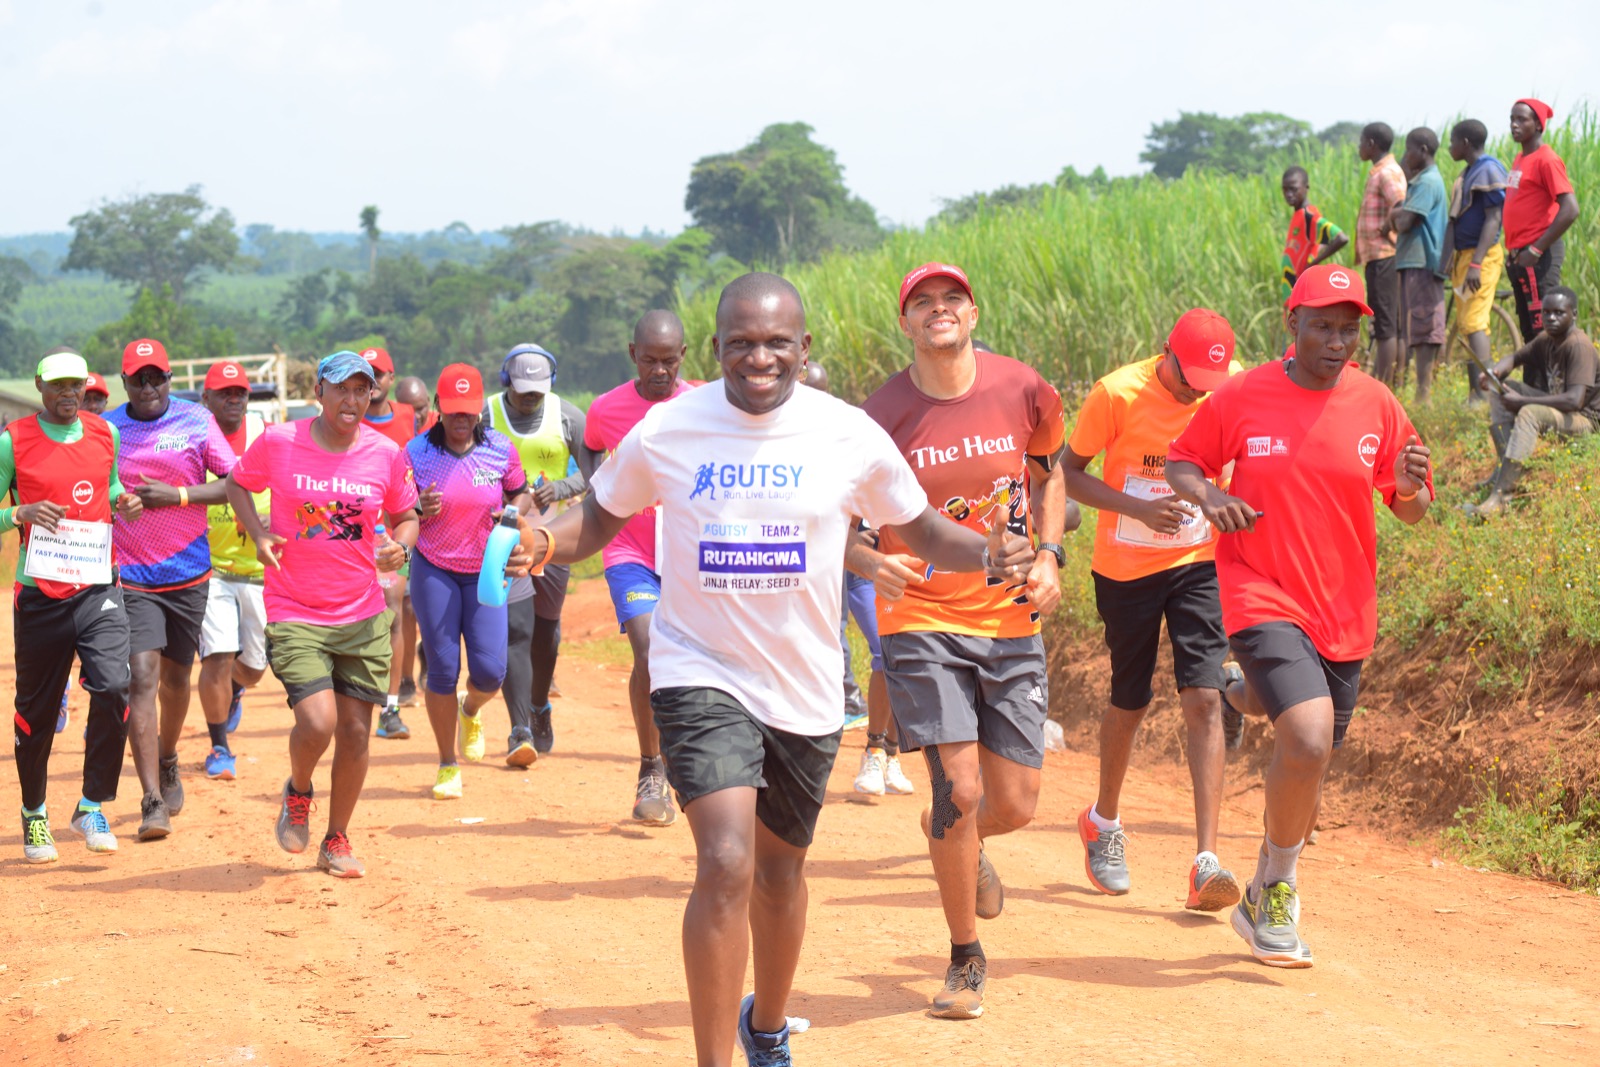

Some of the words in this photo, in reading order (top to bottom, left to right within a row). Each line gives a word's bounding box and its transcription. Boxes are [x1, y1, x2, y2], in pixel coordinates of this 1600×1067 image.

[911, 445, 959, 469] The
[962, 434, 1017, 458] Heat
[1249, 443, 1269, 454] RUN
[1143, 454, 1167, 468] KH3
[719, 464, 803, 488] GUTSY
[293, 473, 329, 492] The
[332, 476, 373, 497] Heat
[1149, 486, 1173, 495] ABSA
[760, 524, 790, 537] TEAM
[793, 525, 800, 537] 2
[34, 535, 66, 545] KAMPALA
[35, 549, 52, 557] FAST
[53, 552, 68, 560] AND
[70, 555, 97, 563] FURIOUS
[703, 549, 801, 567] RUTAHIGWA
[57, 567, 75, 575] SEED
[703, 576, 728, 590] JINJA
[731, 577, 764, 590] RELAY:
[767, 577, 790, 590] SEED
[793, 577, 800, 588] 3
